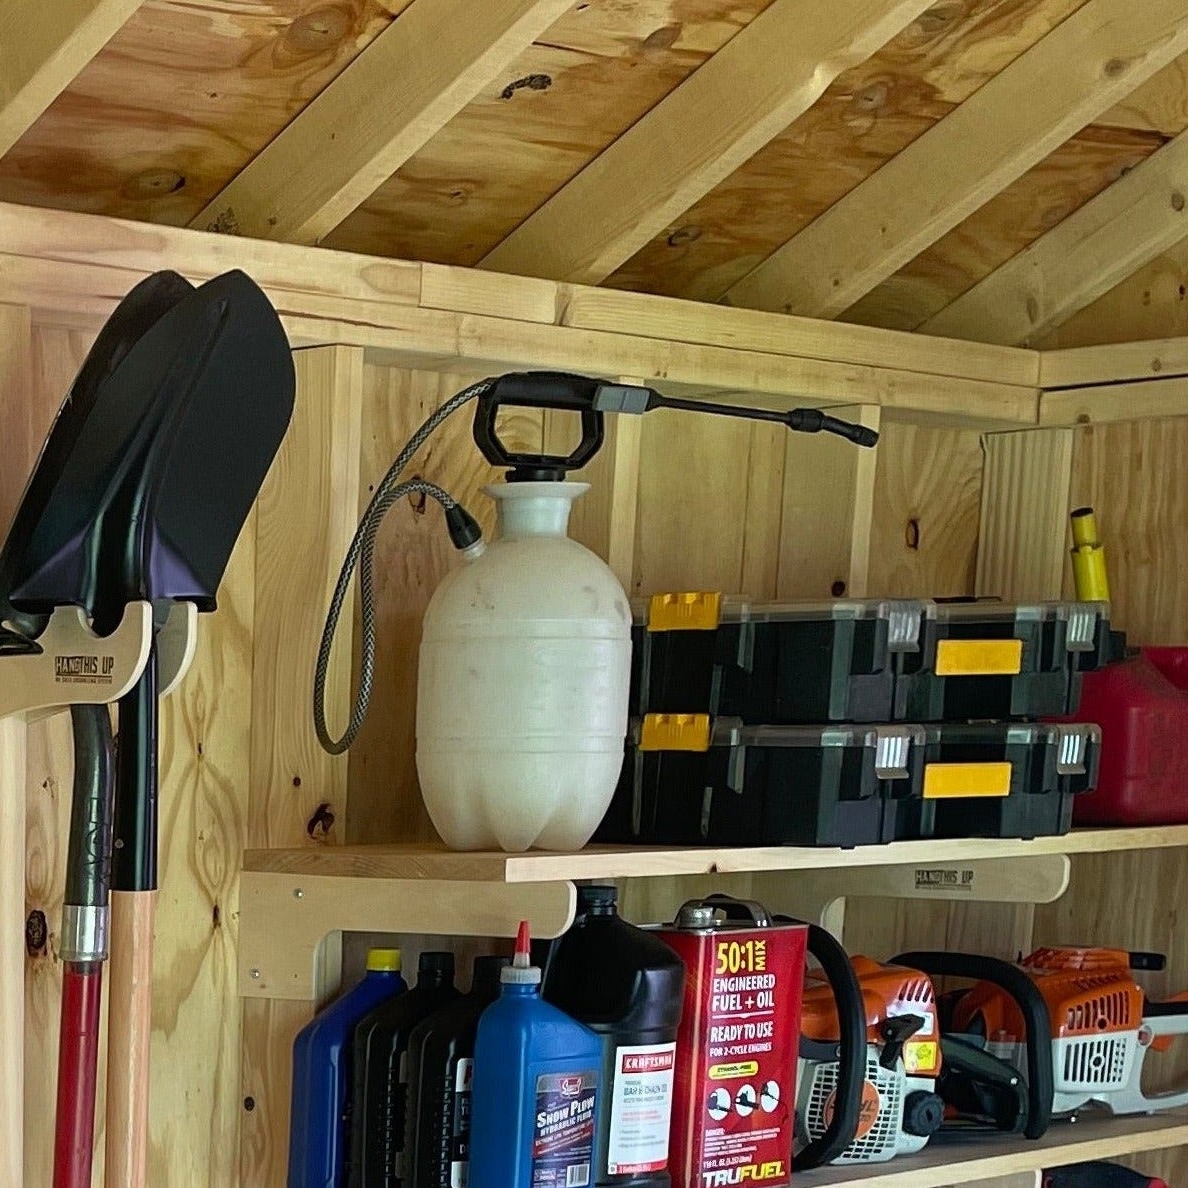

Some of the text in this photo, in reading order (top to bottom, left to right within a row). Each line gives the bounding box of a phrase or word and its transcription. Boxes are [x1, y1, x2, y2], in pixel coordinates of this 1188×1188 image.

[102, 656, 114, 675] UP
[962, 870, 974, 883] UP
[715, 941, 754, 974] 50:1
[755, 940, 766, 970] MIX
[713, 974, 776, 992] ENGINEERED
[712, 991, 775, 1012] FUEL + OIL
[710, 1020, 774, 1043] READY TO USE
[710, 1046, 723, 1057] FOR
[724, 1043, 748, 1055] 2-CYCLE
[624, 1054, 672, 1070] CRAFTSMAN
[536, 1095, 595, 1129] SNOW PLOW
[703, 1161, 786, 1188] TRUFUEL
